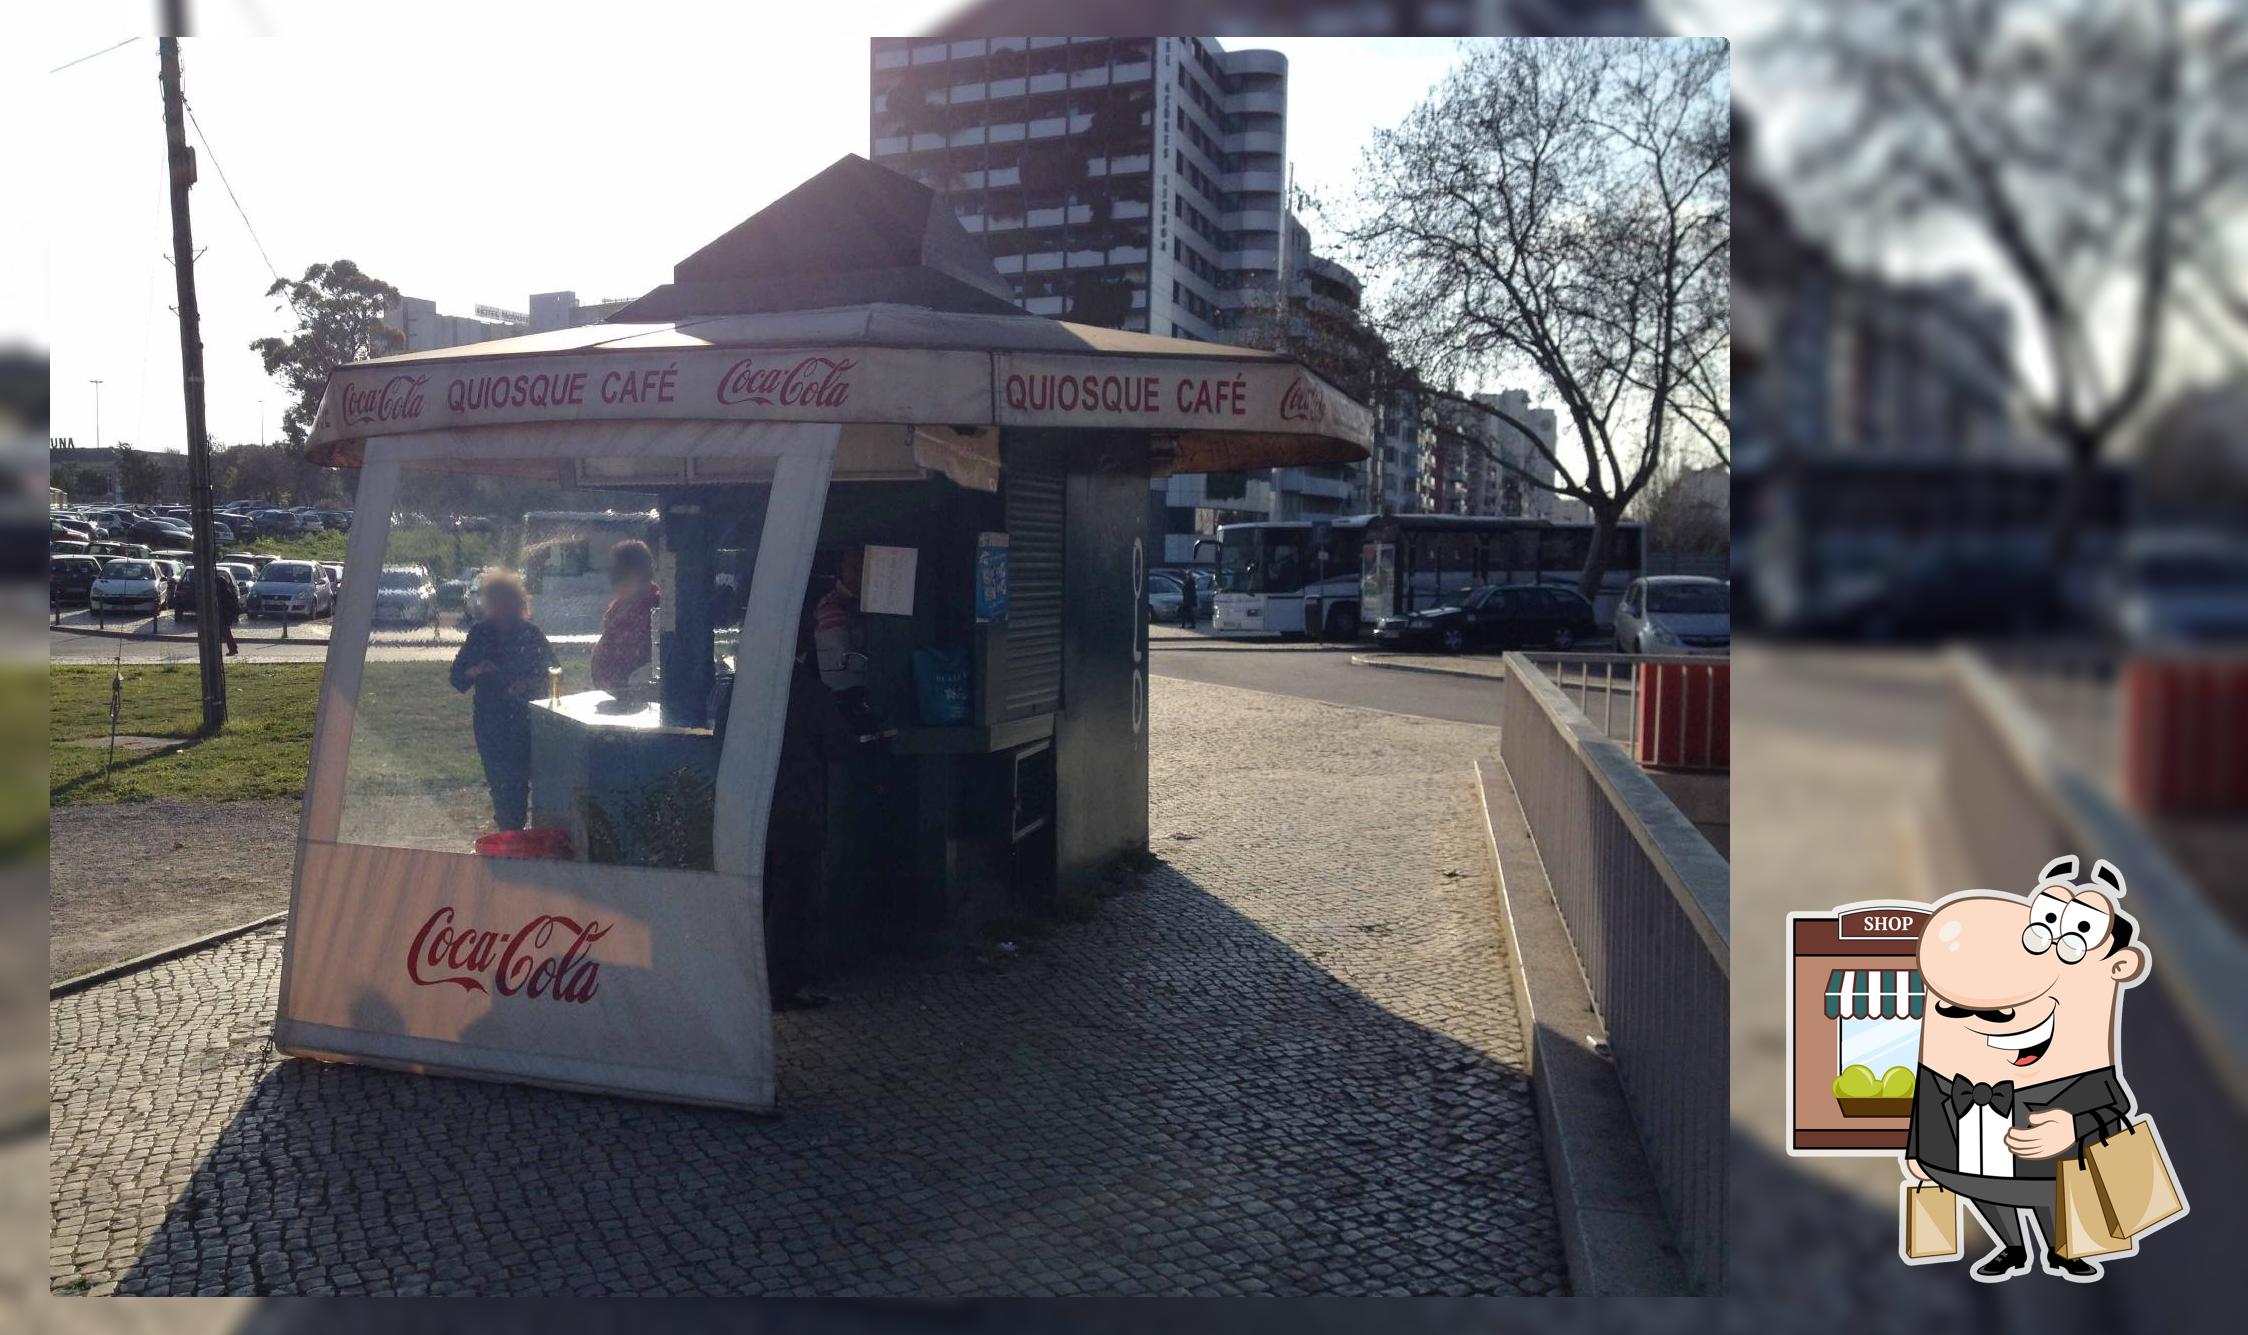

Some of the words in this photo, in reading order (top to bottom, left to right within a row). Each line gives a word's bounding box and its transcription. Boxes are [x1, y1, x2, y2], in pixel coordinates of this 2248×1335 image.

[342, 374, 431, 425] Coca-Cola
[448, 372, 587, 412] QUIOSQUE
[601, 362, 678, 403] CAFÉ
[717, 357, 858, 408] Coca-Cola
[1006, 374, 1160, 414] QUIOSQUE
[1176, 373, 1247, 416] CAFÉ
[407, 907, 614, 1004] Coca-Cola
